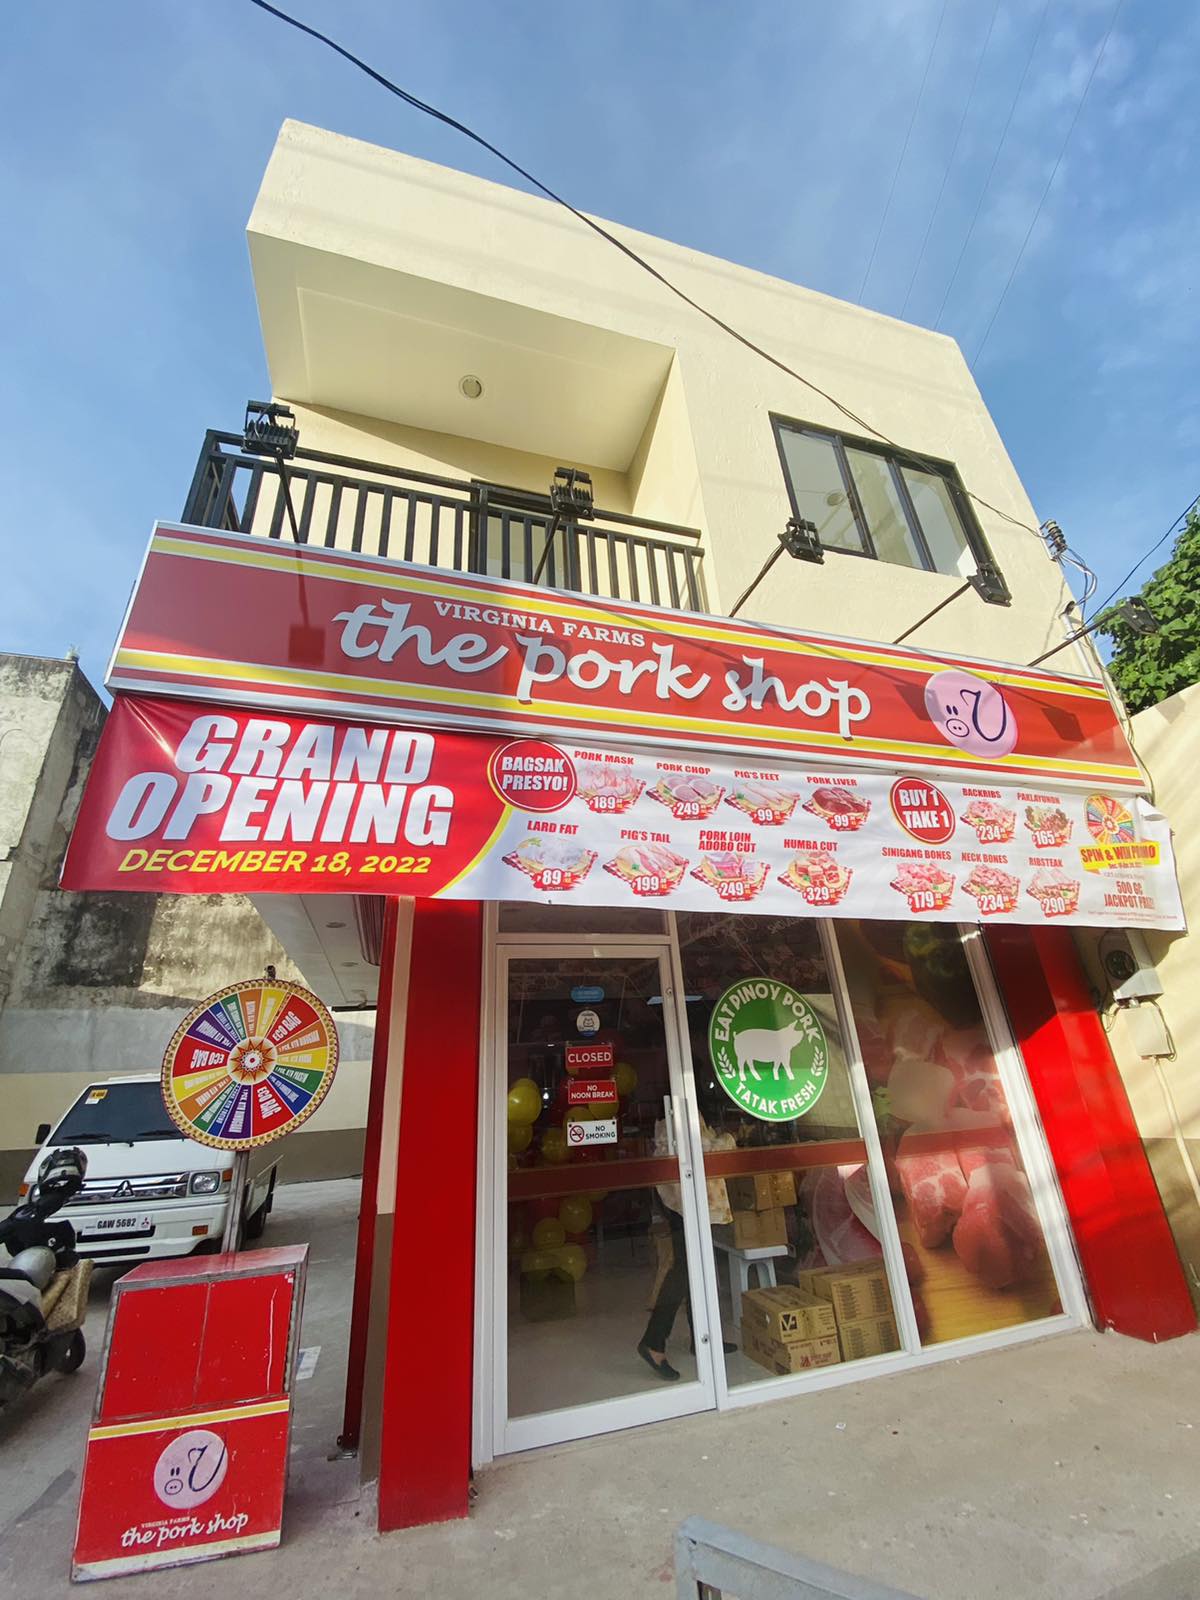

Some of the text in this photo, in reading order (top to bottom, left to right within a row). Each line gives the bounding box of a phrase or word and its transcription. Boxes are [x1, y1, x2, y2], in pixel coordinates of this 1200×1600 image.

[434, 601, 645, 648] VIRGINIA FARMS
[332, 597, 872, 740] the pork shop
[174, 715, 435, 785] GRAND
[574, 750, 635, 765] PORK MASK
[502, 756, 565, 773] BAGSAK
[656, 762, 711, 776] PORK CHOP
[502, 774, 568, 791] PRESYO!
[734, 770, 781, 782] PIG'S FEET
[807, 776, 858, 787] PORK LIVER
[899, 789, 940, 807] BUY 1
[962, 788, 1001, 799] BACKRIBS
[105, 771, 454, 846] OPENING
[903, 810, 950, 829] TAKE 1
[527, 820, 579, 835] LARD FAT
[620, 829, 671, 844] PIG'S TAIL
[699, 830, 752, 842] PORK LOIN
[699, 841, 757, 853] ADOBO CUT
[784, 839, 838, 852] HUMBA CUT
[882, 847, 951, 861] SINIGANG BONES
[961, 852, 1009, 864] NECK BONES
[1081, 848, 1104, 863] SPIN
[1105, 849, 1113, 861] &
[117, 848, 431, 877] DECEMBER 18, 2022
[1104, 893, 1138, 908] JACKPOT
[715, 983, 822, 1043] EAT PINOY PORK
[272, 1023, 289, 1042] ECO
[282, 1011, 302, 1031] BAG
[190, 1049, 224, 1069] ECO BAG
[568, 1051, 612, 1063] CLOSED
[571, 1090, 614, 1099] NOON BREAK
[735, 1080, 817, 1114] TATAK FRESH
[257, 1086, 282, 1120] ECO BAG
[585, 1131, 616, 1140] SMOKING
[121, 1512, 249, 1548] the pork shop
